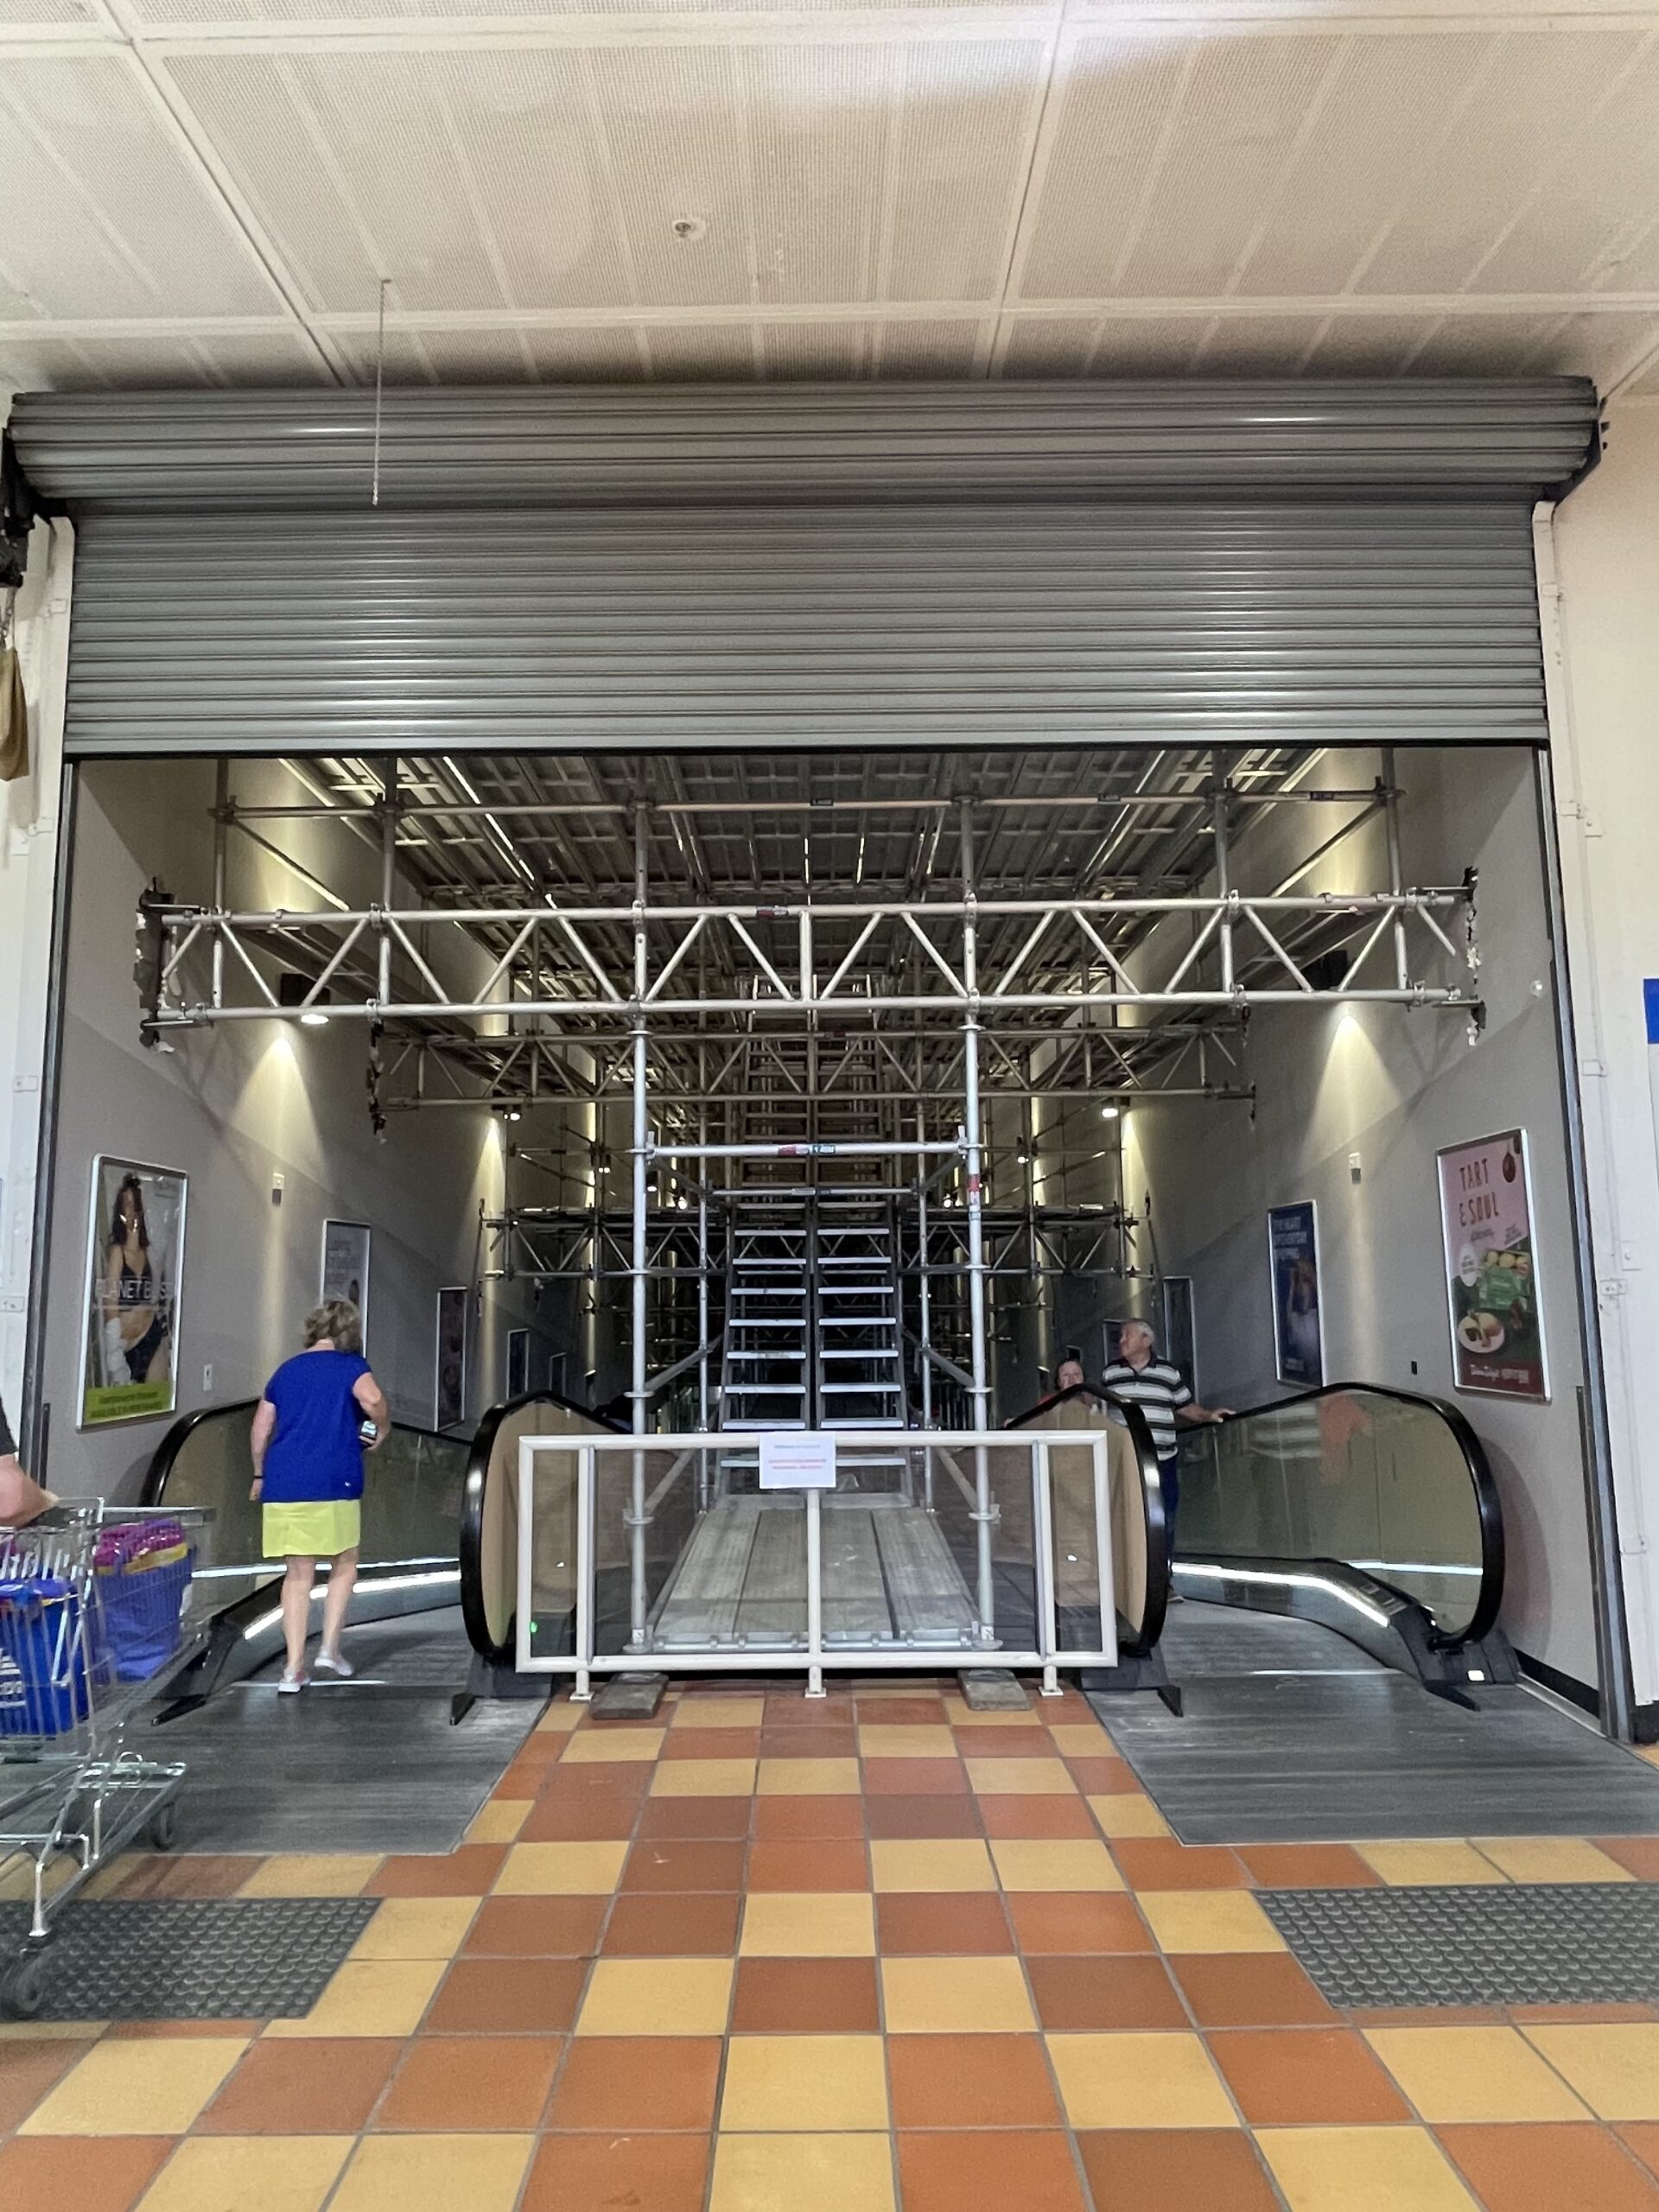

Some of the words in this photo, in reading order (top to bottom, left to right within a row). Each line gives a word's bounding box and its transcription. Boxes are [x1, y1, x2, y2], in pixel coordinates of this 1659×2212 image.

[1459, 1158, 1490, 1192] TART
[1468, 1192, 1499, 1225] SOUL
[96, 1279, 143, 1299] PLANET
